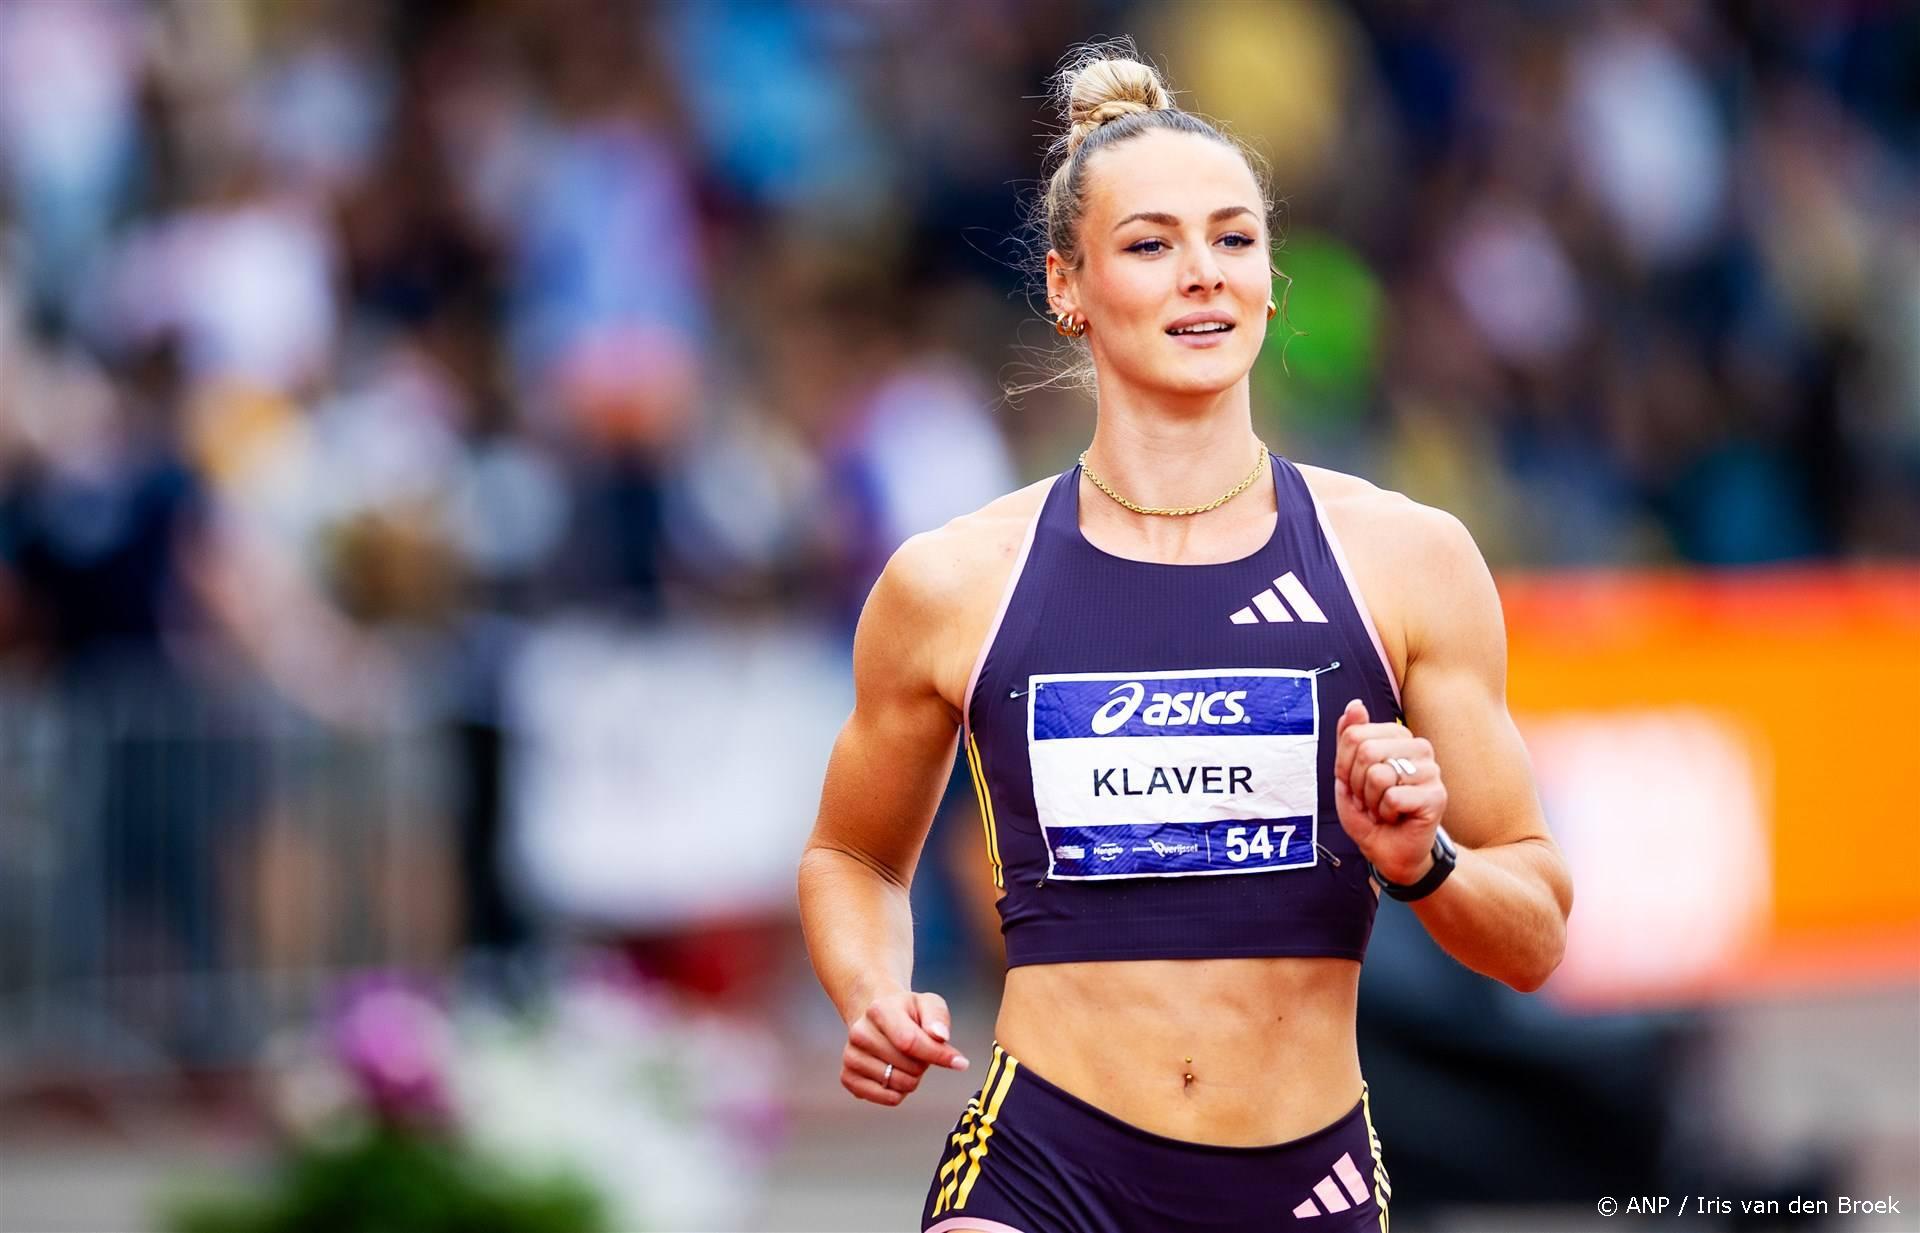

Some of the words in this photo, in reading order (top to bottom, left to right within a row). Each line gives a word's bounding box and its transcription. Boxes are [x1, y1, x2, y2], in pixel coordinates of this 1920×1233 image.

[1142, 691, 1247, 726] asics
[1093, 766, 1254, 797] KLAVER
[1226, 825, 1297, 862] 547
